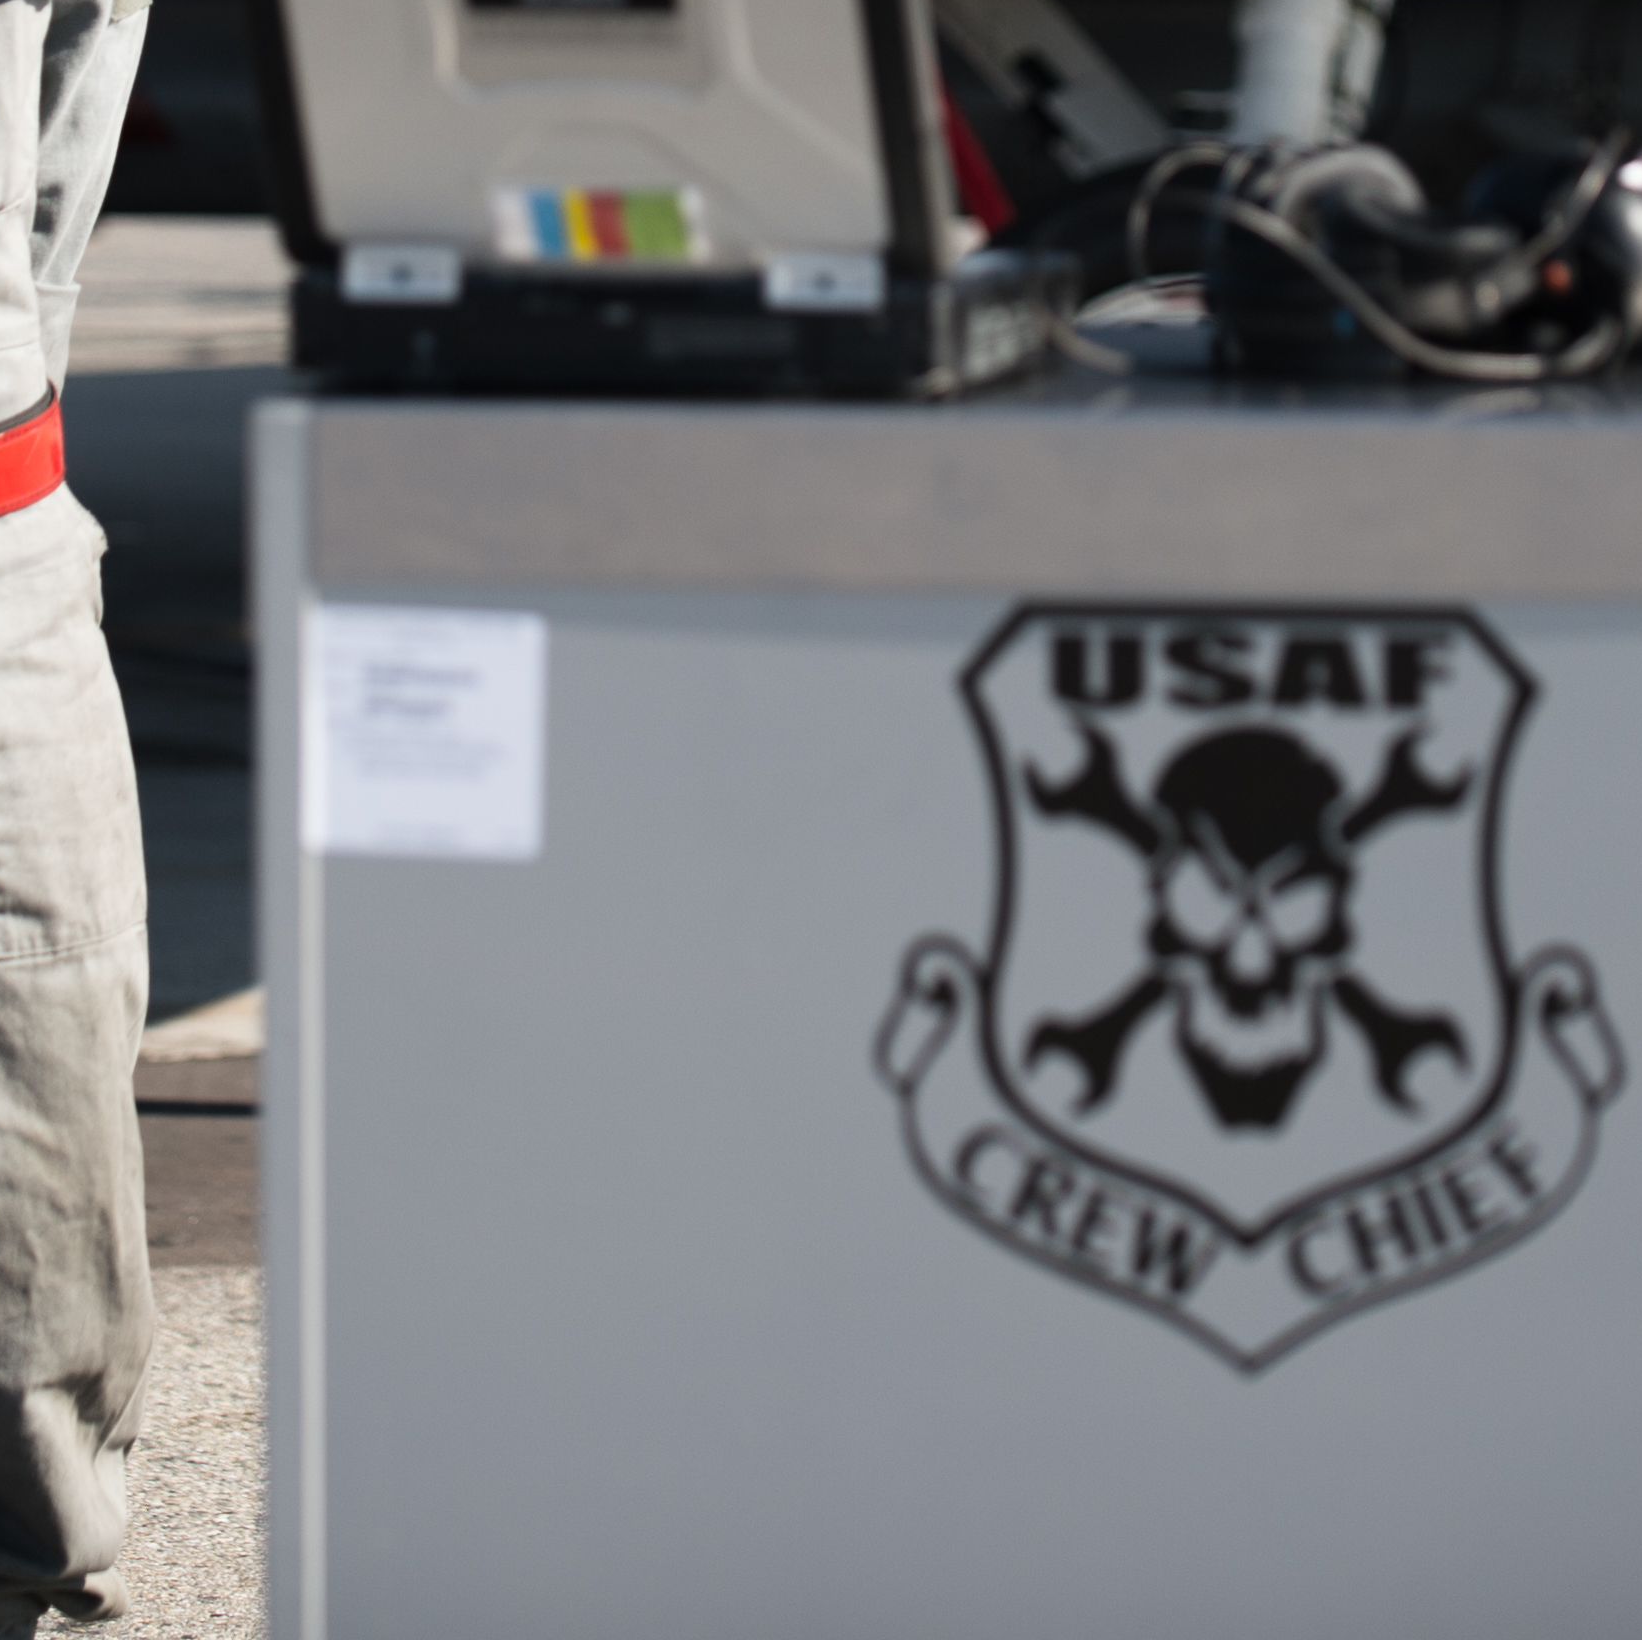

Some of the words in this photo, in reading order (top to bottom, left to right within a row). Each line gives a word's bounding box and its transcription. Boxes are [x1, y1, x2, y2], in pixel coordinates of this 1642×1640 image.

[1049, 629, 1452, 710] USAF
[954, 1124, 1222, 1298] CREW
[1287, 1124, 1544, 1298] CHIEF
